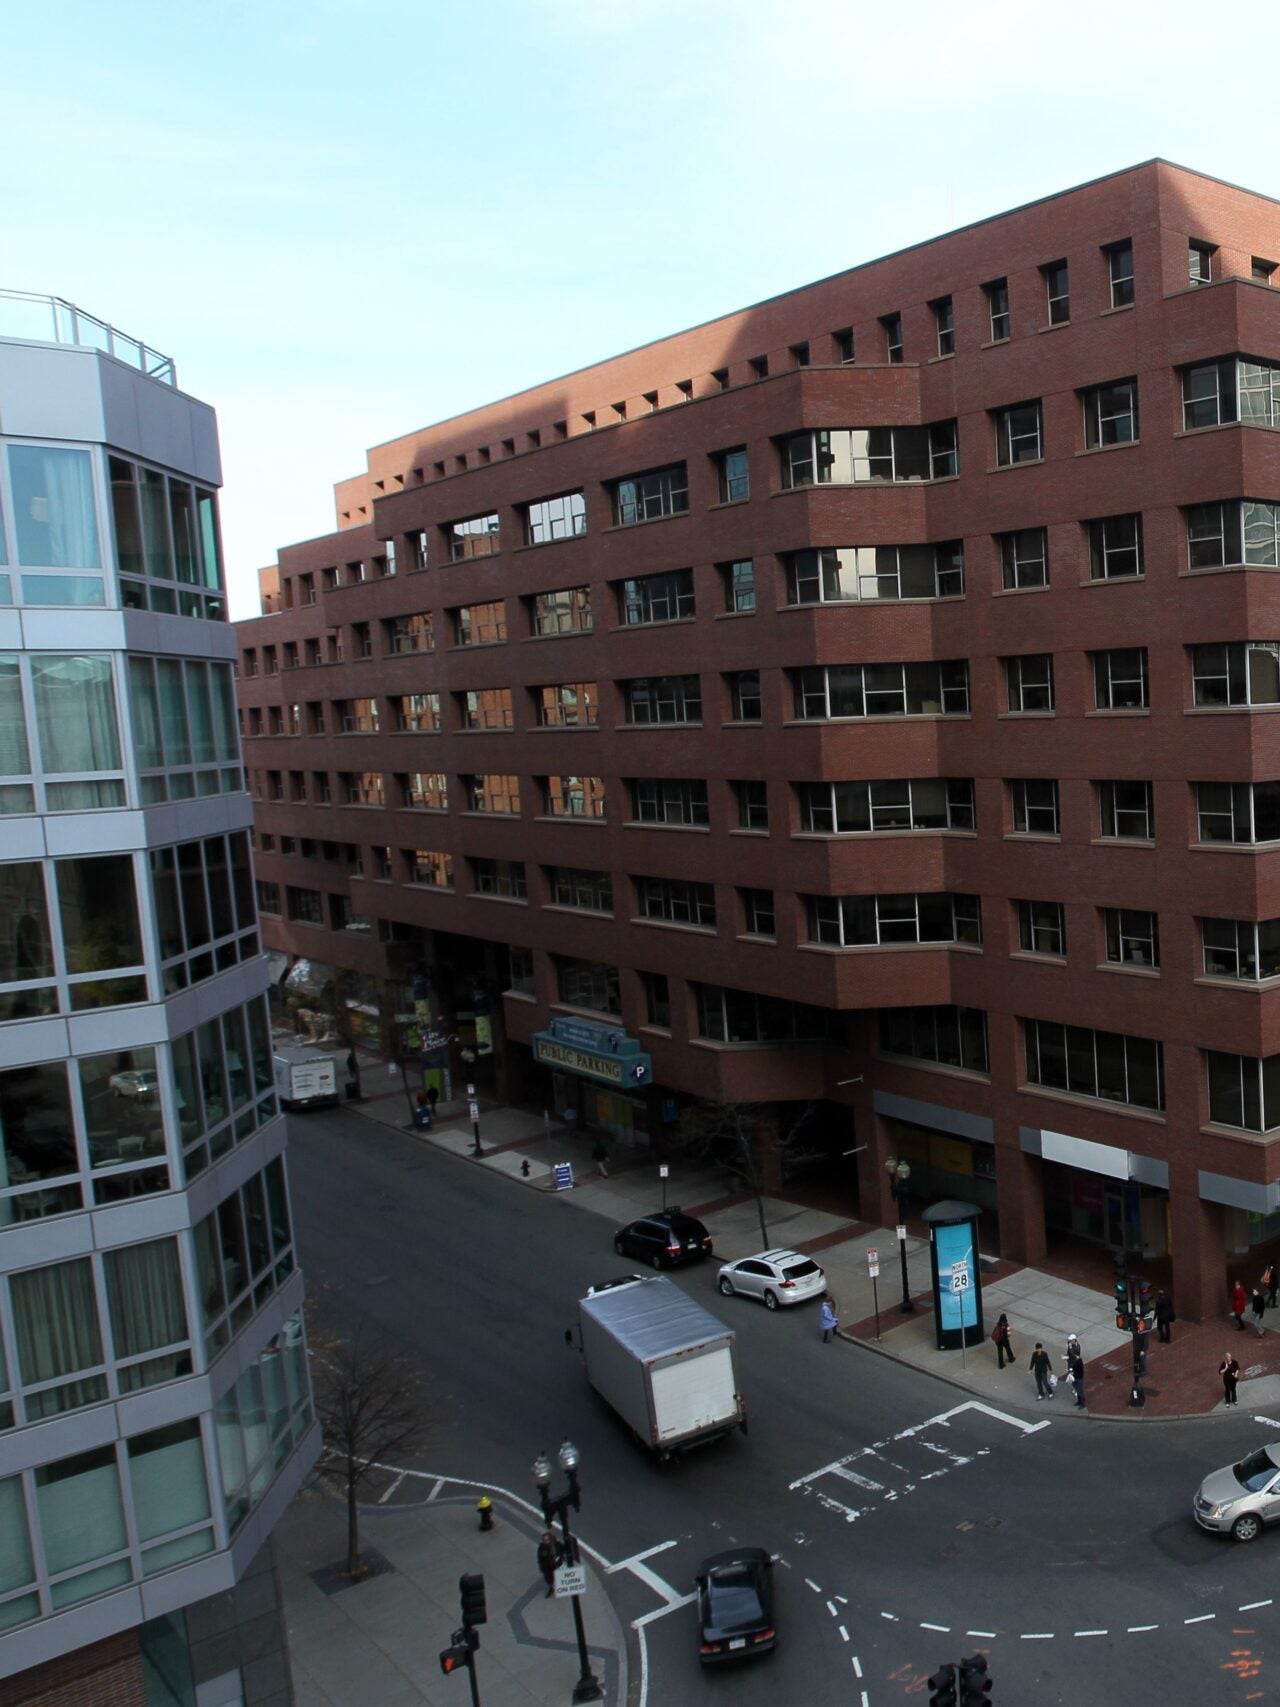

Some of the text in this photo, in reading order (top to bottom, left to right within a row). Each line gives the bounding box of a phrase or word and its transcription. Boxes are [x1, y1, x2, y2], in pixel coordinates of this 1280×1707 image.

[540, 1043, 620, 1077] PUBLIC PARKING
[636, 1066, 645, 1077] P
[952, 1260, 968, 1271] NORTH
[954, 1274, 968, 1288] 28
[561, 1577, 581, 1586] TURN
[556, 1583, 585, 1594] ON RED
